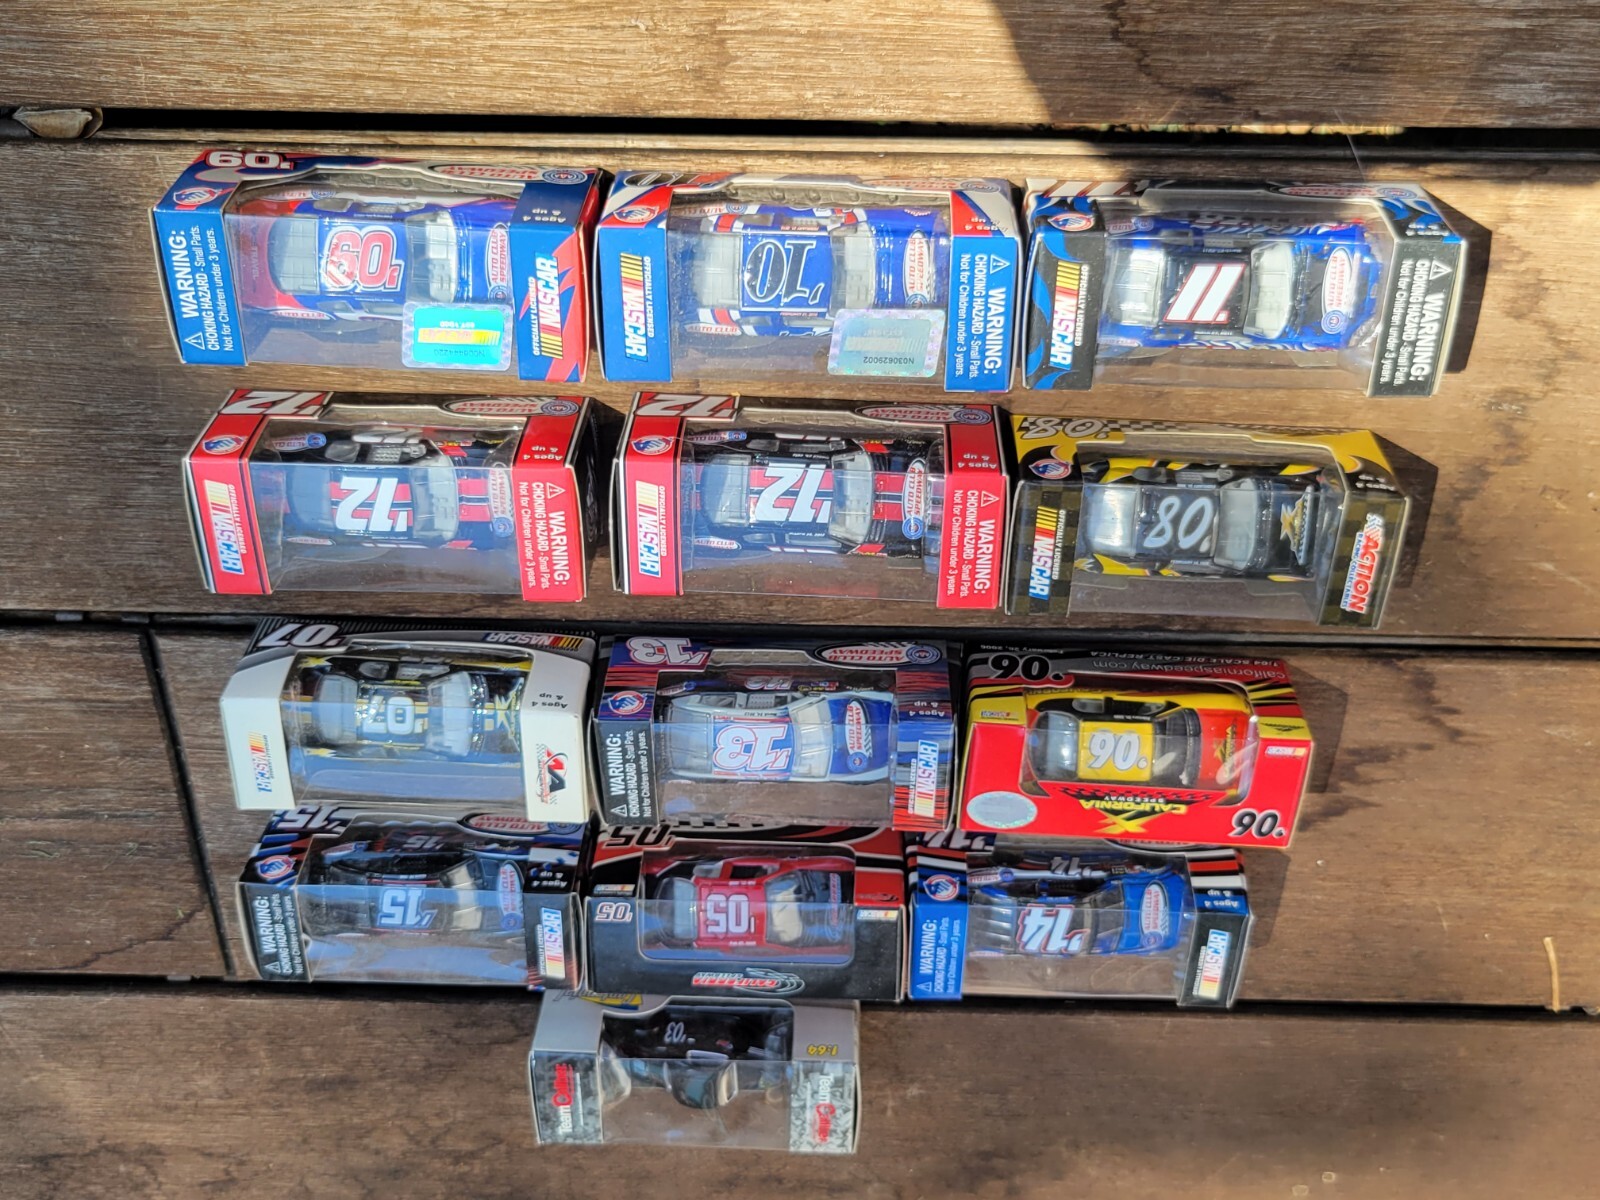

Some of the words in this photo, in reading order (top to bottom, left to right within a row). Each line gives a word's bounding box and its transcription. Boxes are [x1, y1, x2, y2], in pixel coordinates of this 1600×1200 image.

[206, 150, 293, 170] '09
[190, 226, 202, 246] Parts.
[206, 228, 220, 253] years.
[194, 248, 206, 267] Small
[325, 230, 401, 288] '09
[961, 254, 970, 269] Not
[1401, 261, 1412, 274] Not
[168, 230, 199, 318] WARNING:
[211, 263, 223, 287] under
[643, 256, 653, 300] OFFICIALLY
[974, 254, 987, 297] CHOKING
[1076, 264, 1089, 313] OFFICIALLY
[1335, 258, 1345, 307] SPEEDWAY
[1398, 277, 1407, 289] for
[1410, 261, 1428, 302] CHOKING
[197, 273, 213, 310] HAZARD
[216, 288, 229, 322] Children
[529, 277, 537, 313] LICENSED
[958, 284, 968, 311] Children
[1163, 263, 1245, 324] '11
[624, 288, 646, 357] NASCAR
[646, 303, 655, 337] LICENSED
[972, 297, 983, 333] HAZARD
[1391, 291, 1406, 325] Children
[1405, 305, 1420, 340] HAZARD
[204, 311, 220, 350] CHOKING
[221, 324, 230, 334] for
[224, 336, 234, 351] Not
[984, 288, 1006, 374] WARNING:
[1049, 295, 1076, 365] NASCAR
[1075, 315, 1083, 346] LICENSED
[1387, 328, 1398, 349] under
[1410, 293, 1444, 380] WARNING:
[863, 356, 914, 364] N030629002
[971, 340, 981, 357] Small
[1397, 347, 1409, 363] Small
[955, 353, 963, 376] years.
[969, 359, 980, 379] Parts.
[1380, 360, 1393, 383] years.
[1393, 366, 1405, 385] Parts.
[219, 391, 321, 414] '12
[634, 393, 733, 416] '12
[335, 475, 408, 532] '12
[499, 471, 507, 515] SPEEDWAY
[754, 462, 831, 524] '12
[954, 490, 962, 501] Not
[228, 483, 240, 522] OFFICIALLY
[235, 523, 247, 553] LICENSED
[952, 504, 961, 515] for
[965, 490, 978, 526] CHOKING
[951, 517, 961, 546] Children
[1057, 510, 1065, 547] OFFICIALLY
[1143, 495, 1213, 553] '08
[214, 512, 242, 569] NASCAR
[549, 511, 570, 585] WARNING:
[639, 512, 659, 572] NASCAR
[965, 528, 976, 559] HAZARD
[1351, 533, 1363, 556] RACING
[949, 548, 957, 568] under
[974, 519, 995, 593] WARNING:
[1029, 534, 1054, 595] NASCAR
[1052, 549, 1062, 579] LICENSED
[947, 576, 956, 596] years.
[962, 565, 970, 581] Small
[1341, 557, 1358, 608] COLLECTABLES
[1347, 534, 1379, 612] ACTION
[960, 582, 970, 597] Parts.
[258, 623, 346, 647] '07
[487, 633, 553, 646] NASCAR
[626, 637, 707, 666] '13
[1090, 651, 1139, 659] REPLICA
[988, 654, 1064, 681] '06
[1093, 660, 1286, 680] californiaspeedway.com
[625, 730, 633, 744] Parts.
[639, 731, 649, 749] years.
[712, 726, 792, 771] '13
[1087, 728, 1148, 771] '06
[606, 734, 626, 795] WARNING:
[626, 745, 635, 759] Small
[626, 763, 637, 788] HAZARD
[918, 746, 937, 792] NASCAR
[640, 774, 650, 797] Children
[908, 785, 916, 814] OFFICIALLY
[628, 790, 640, 817] CHOKING
[643, 806, 651, 817] Not
[1079, 800, 1187, 813] CALIFORNIA
[1228, 808, 1285, 838] '06
[381, 888, 437, 927] '15
[595, 903, 632, 922] '05
[706, 893, 754, 933] '05
[1213, 900, 1238, 908] Ages
[546, 913, 562, 955] NASCAR
[1016, 904, 1089, 953] '14
[1204, 933, 1229, 978] NASCAR
[664, 1022, 686, 1044] '03
[807, 1044, 838, 1055] 1:64
